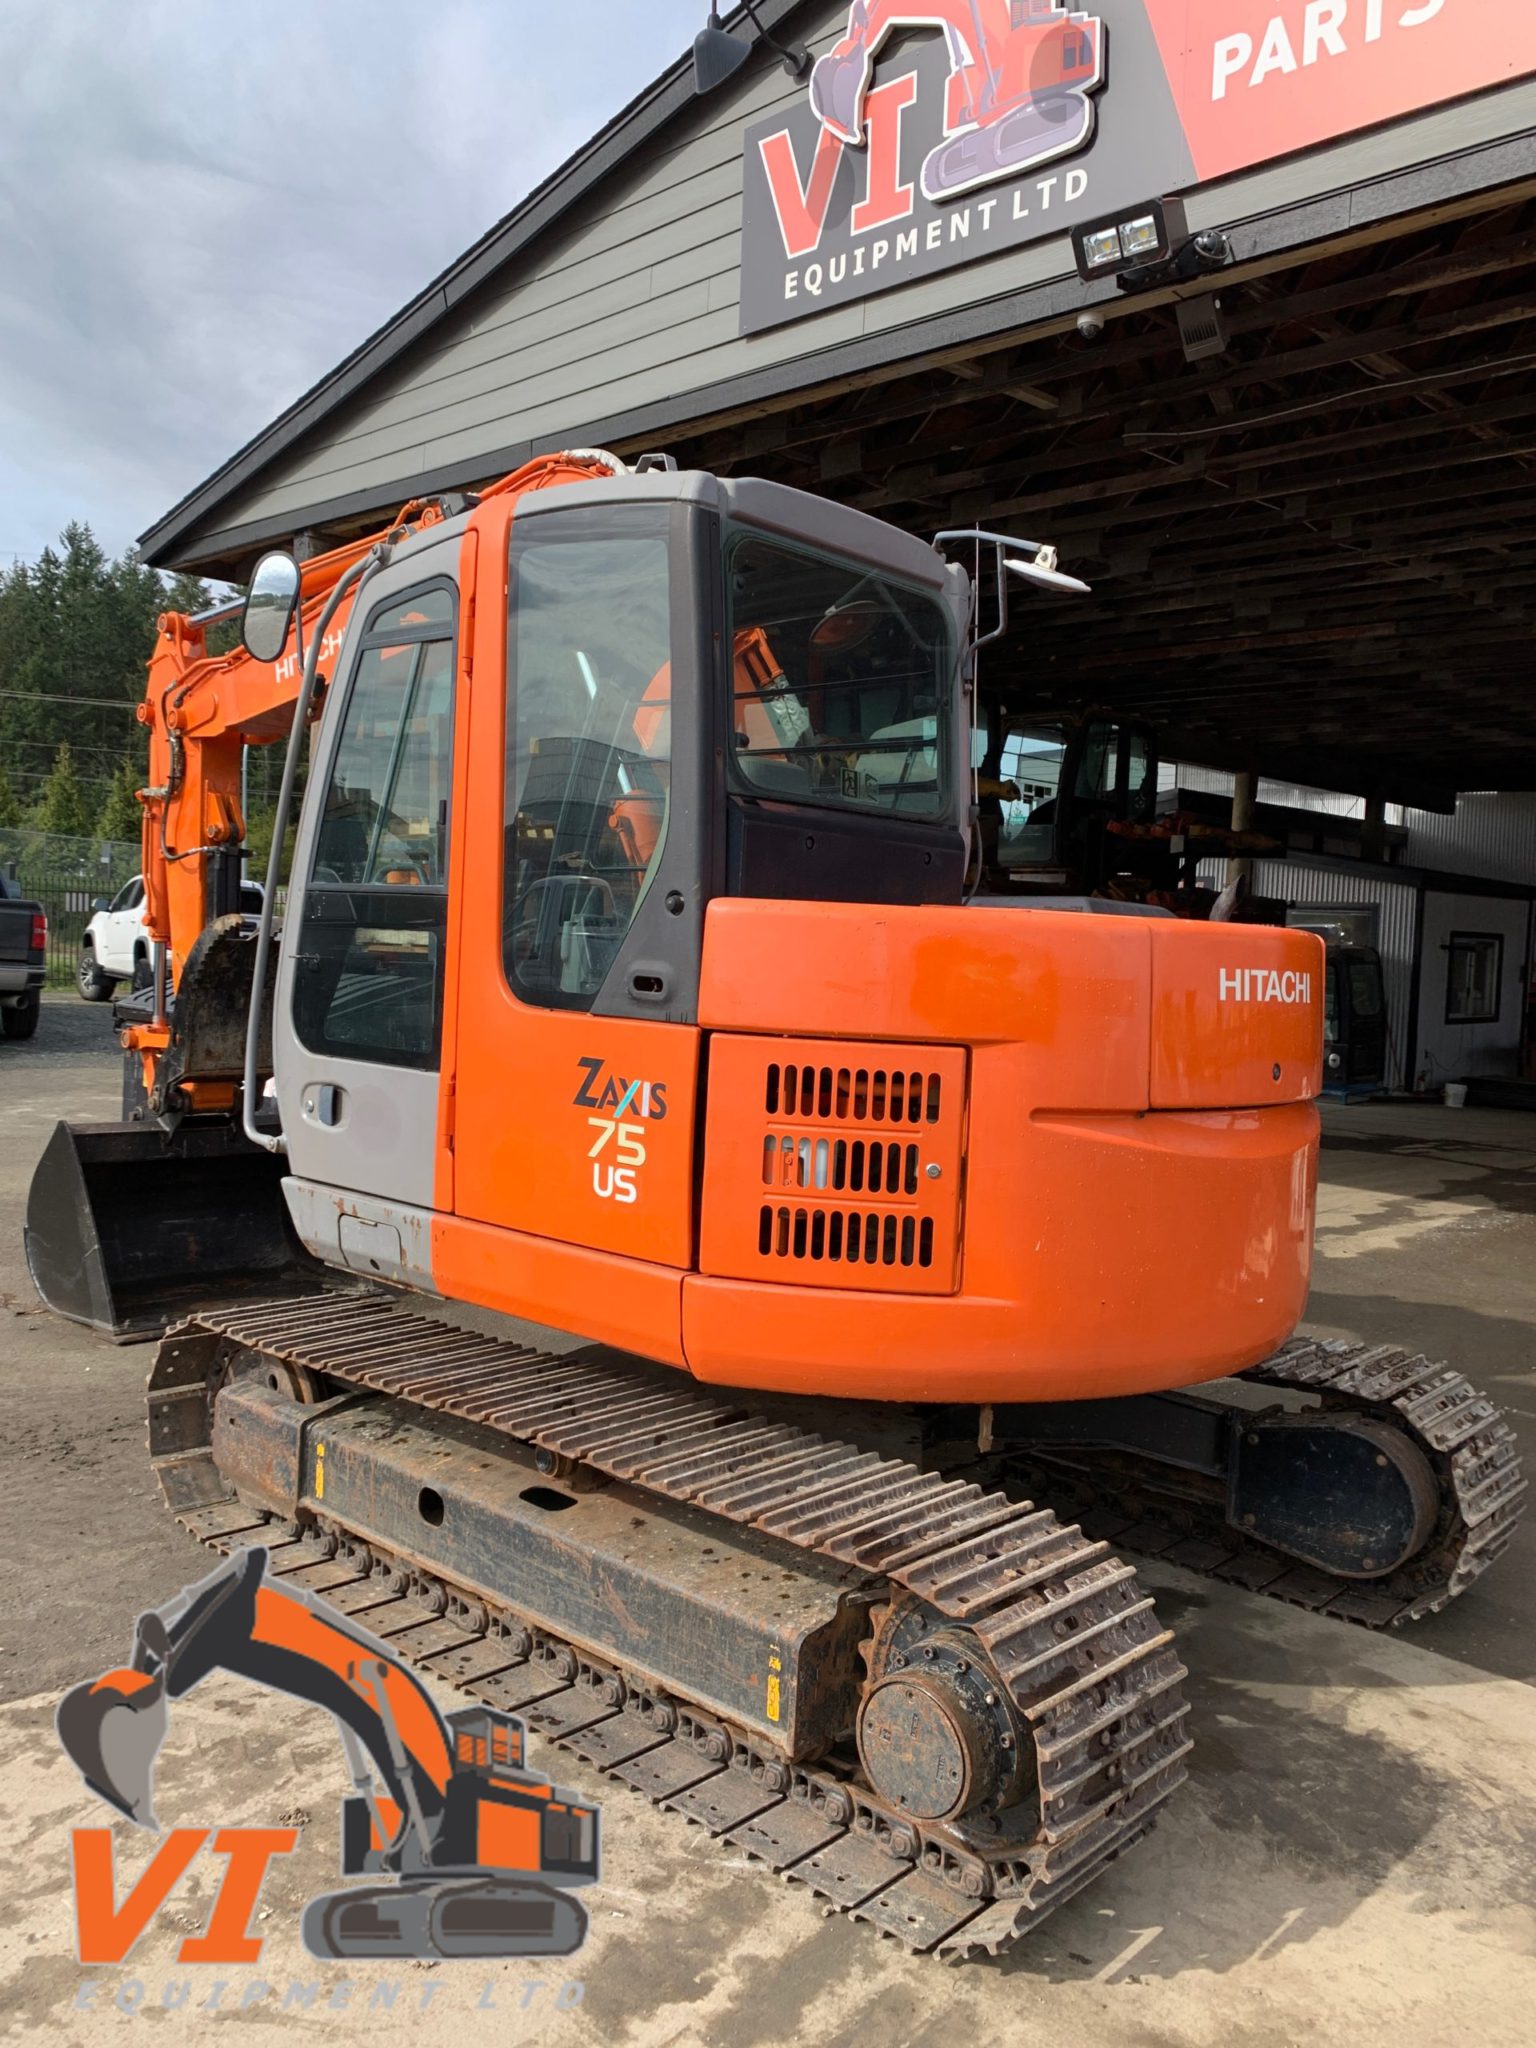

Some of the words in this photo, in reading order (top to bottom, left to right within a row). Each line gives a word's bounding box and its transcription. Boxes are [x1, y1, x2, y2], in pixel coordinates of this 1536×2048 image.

[757, 69, 918, 260] VI
[784, 198, 998, 300] EQUIPMENT
[1012, 168, 1089, 221] LTD
[1219, 967, 1311, 1004] HITACHI
[572, 1056, 668, 1121] ZAXIS
[587, 1116, 647, 1167] 75
[592, 1162, 638, 1204] US
